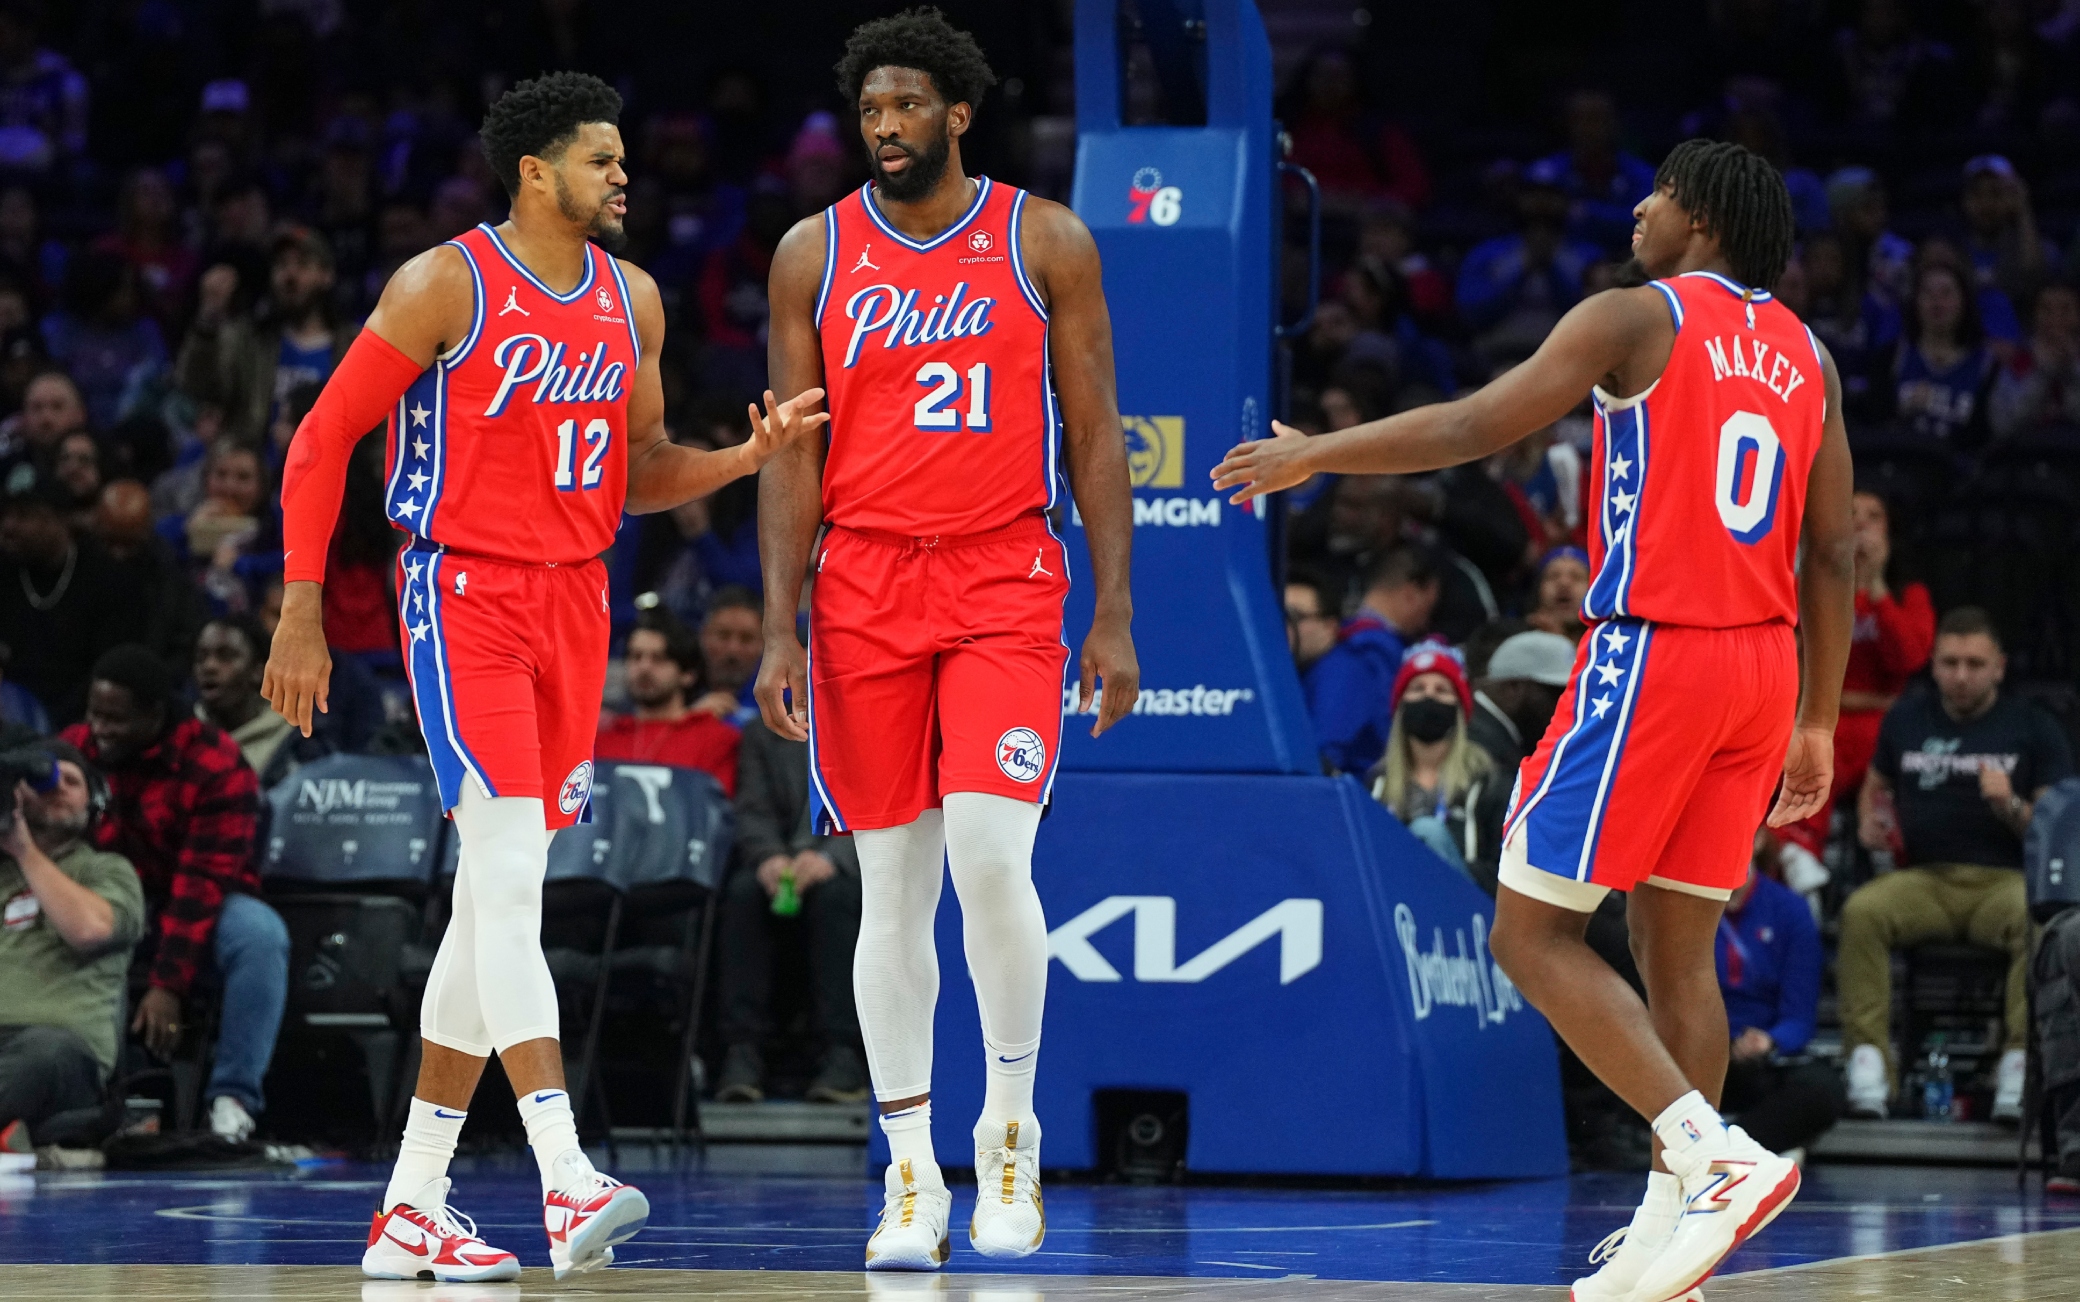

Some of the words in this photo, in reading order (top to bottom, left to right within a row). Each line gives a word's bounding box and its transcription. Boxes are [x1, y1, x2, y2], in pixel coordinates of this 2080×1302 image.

[1127, 186, 1183, 226] 76
[958, 256, 1004, 264] crypto.com
[593, 314, 625, 324] crypto.com
[843, 281, 997, 369] Phila
[484, 333, 626, 418] Phila
[914, 362, 992, 433] 21
[1704, 335, 1805, 403] MAXEY
[555, 418, 612, 491] 12
[1715, 410, 1787, 546] 0
[1072, 497, 1222, 527] MGM
[1001, 743, 1039, 773] 76ers
